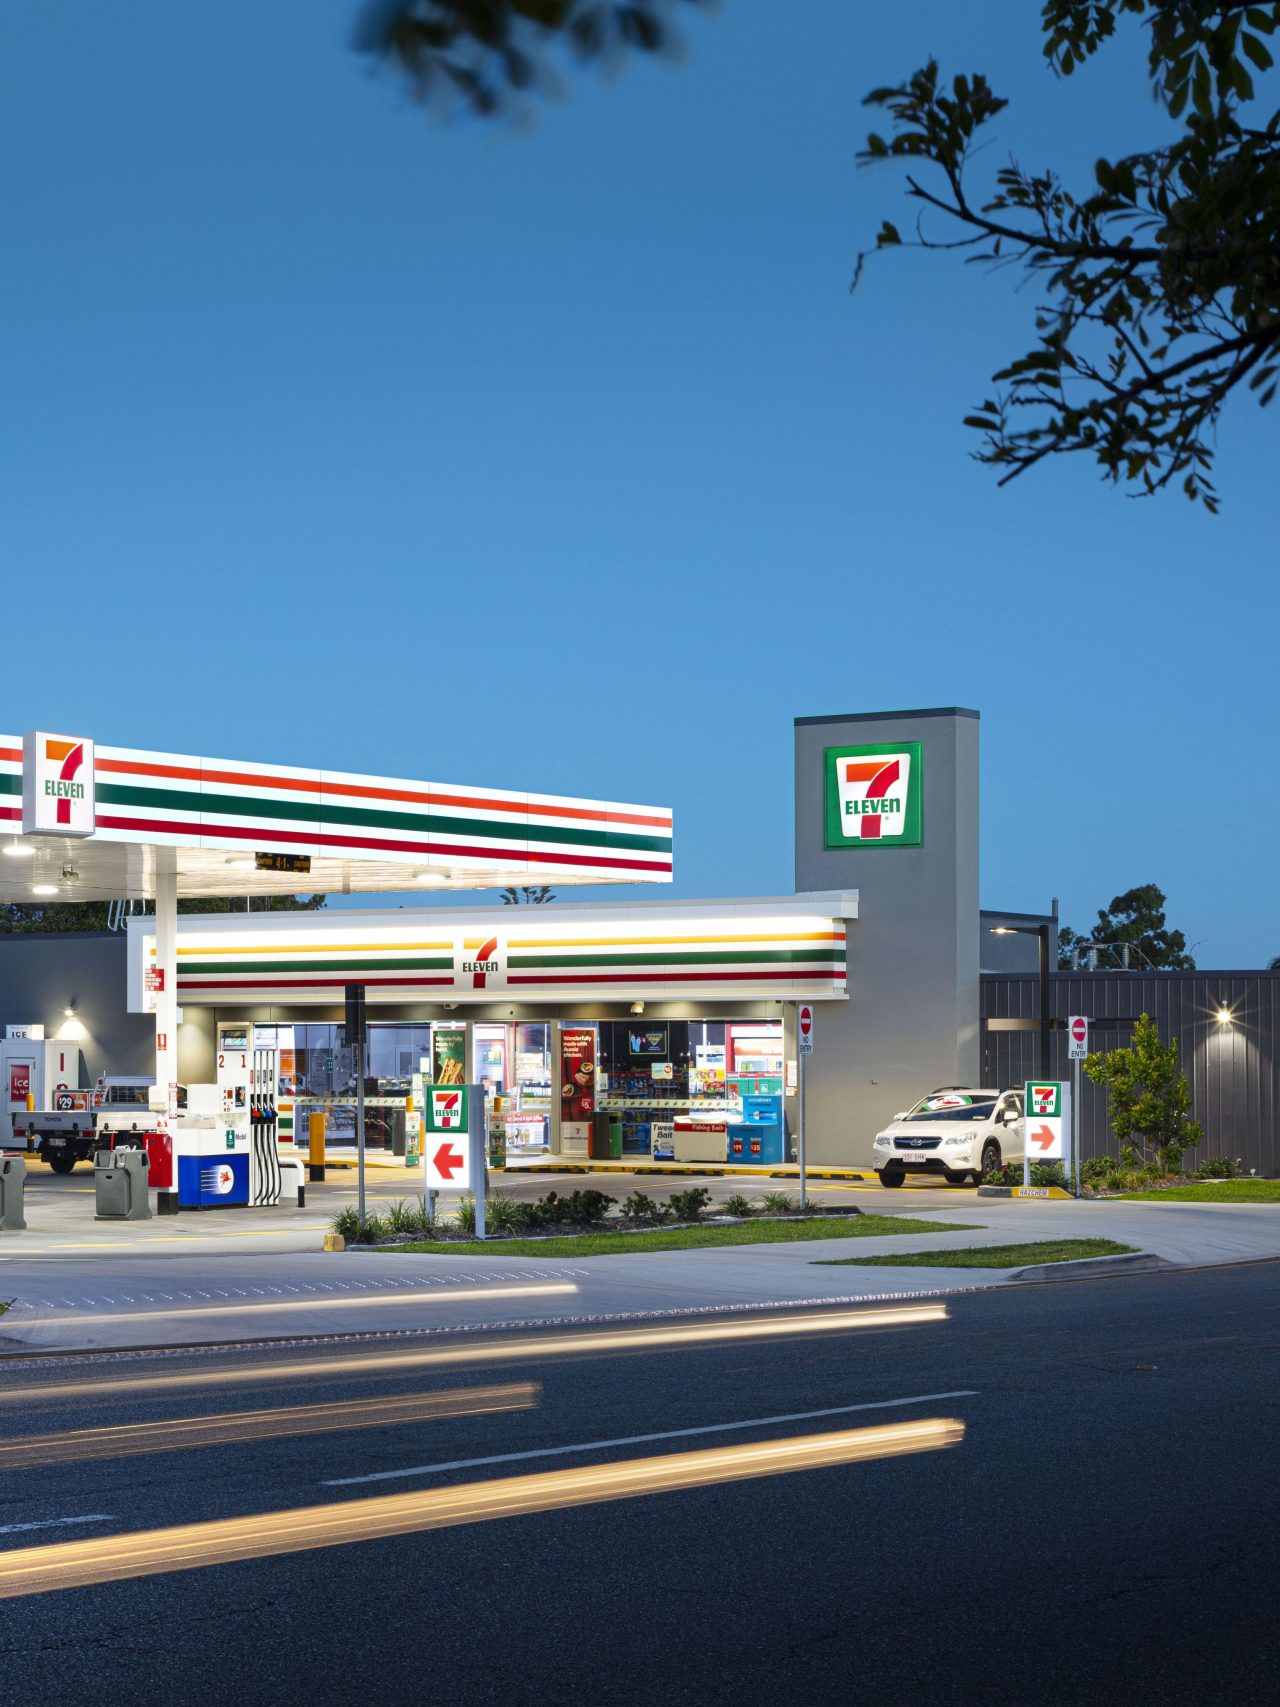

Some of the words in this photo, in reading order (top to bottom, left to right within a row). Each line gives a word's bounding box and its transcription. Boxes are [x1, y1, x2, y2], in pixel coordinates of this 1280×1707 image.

[46, 740, 83, 824] 7
[846, 760, 900, 838] 7
[463, 936, 497, 989] 7
[218, 1054, 225, 1068] 2
[241, 1054, 246, 1068] 1
[1071, 1050, 1086, 1058] ENTRY
[14, 1077, 29, 1087] Ice
[59, 1097, 73, 1109] $29
[1034, 1088, 1054, 1114] 7
[435, 1093, 459, 1128] 7
[692, 1124, 710, 1132] Fishing
[711, 1123, 724, 1131] Bait
[657, 1131, 673, 1139] Bait
